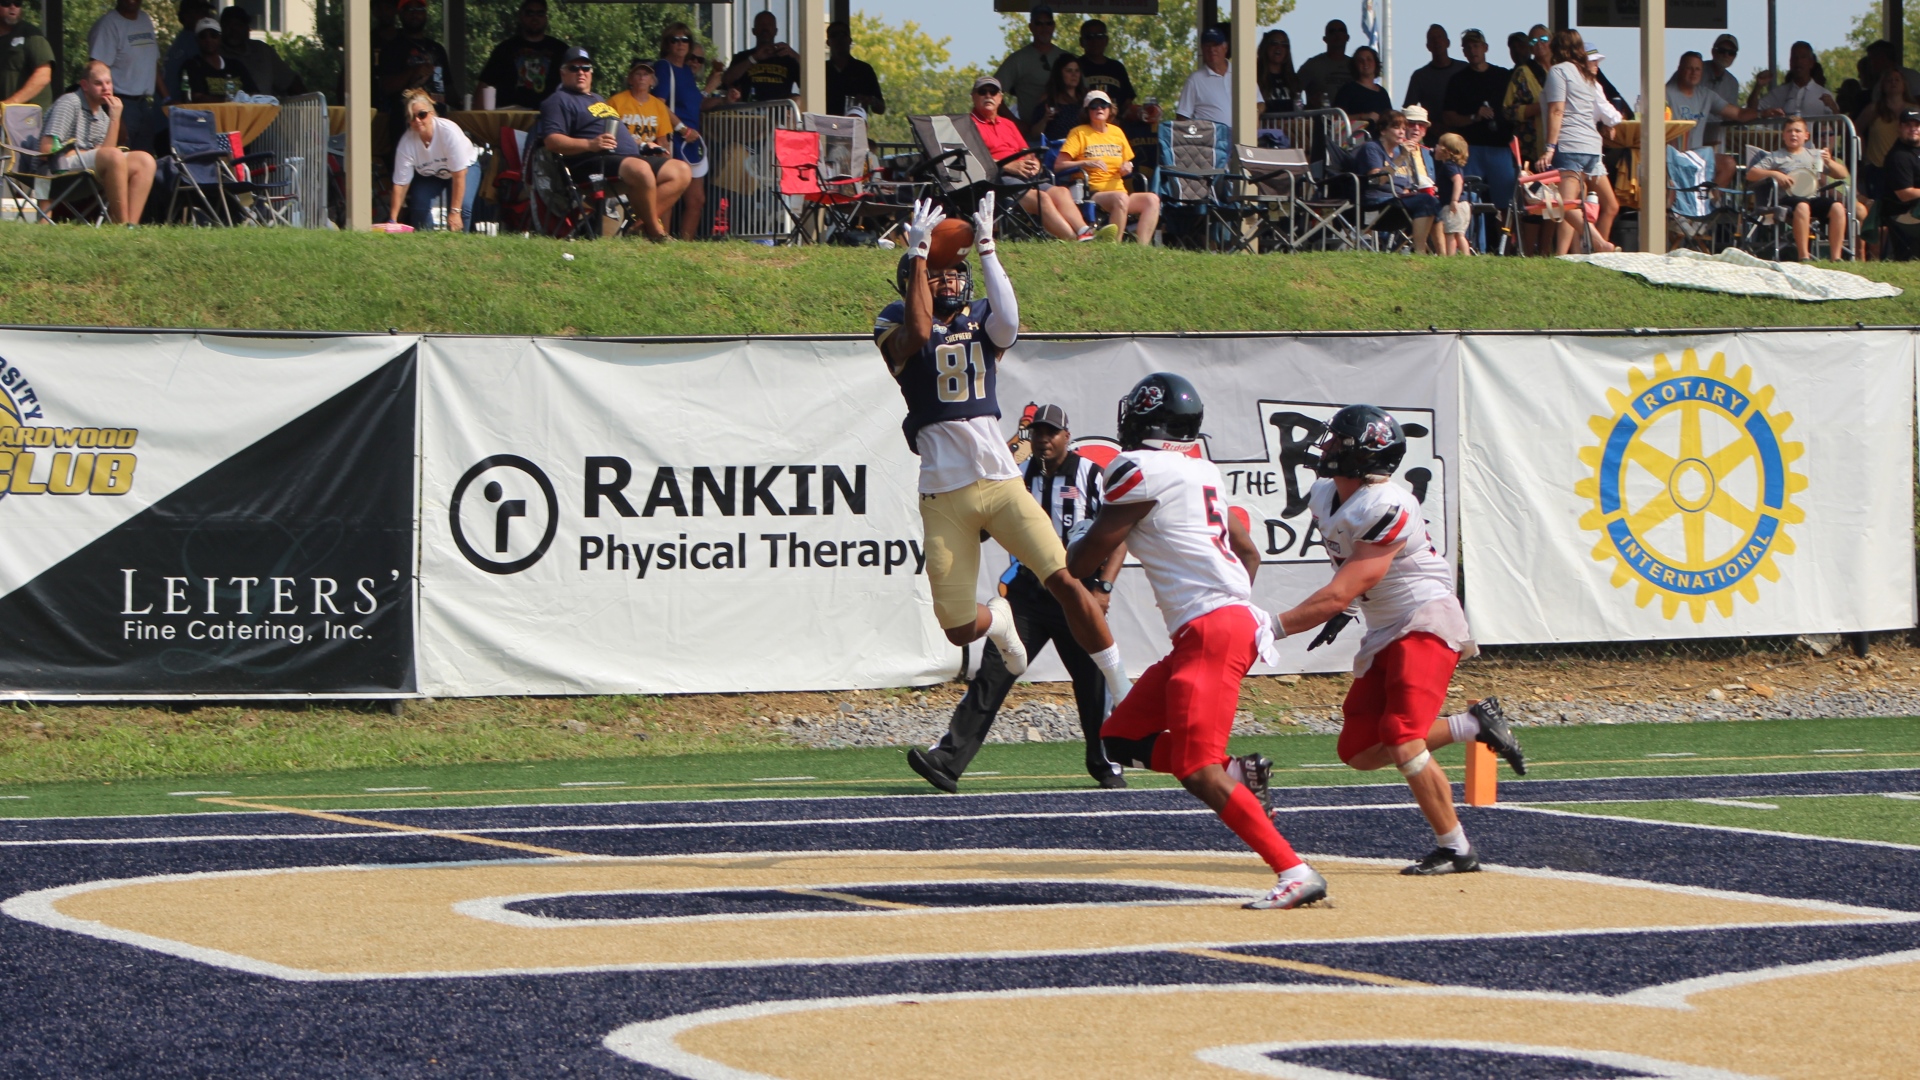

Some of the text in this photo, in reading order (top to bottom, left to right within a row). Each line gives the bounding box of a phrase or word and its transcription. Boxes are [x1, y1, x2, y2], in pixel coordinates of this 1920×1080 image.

[622, 113, 658, 127] HAVE
[0, 355, 44, 421] SITY
[934, 341, 988, 403] 81
[1641, 381, 1743, 412] ROTARY
[0, 425, 139, 449] ARDWOOD
[583, 455, 868, 519] RANKIN
[1226, 470, 1278, 497] THE
[1063, 513, 1074, 527] S
[1202, 485, 1238, 564] 5
[579, 531, 927, 580] Physical Therapy
[1618, 533, 1771, 589] INTERNATIONAL
[123, 619, 374, 645] Fine Catering, Inc.
